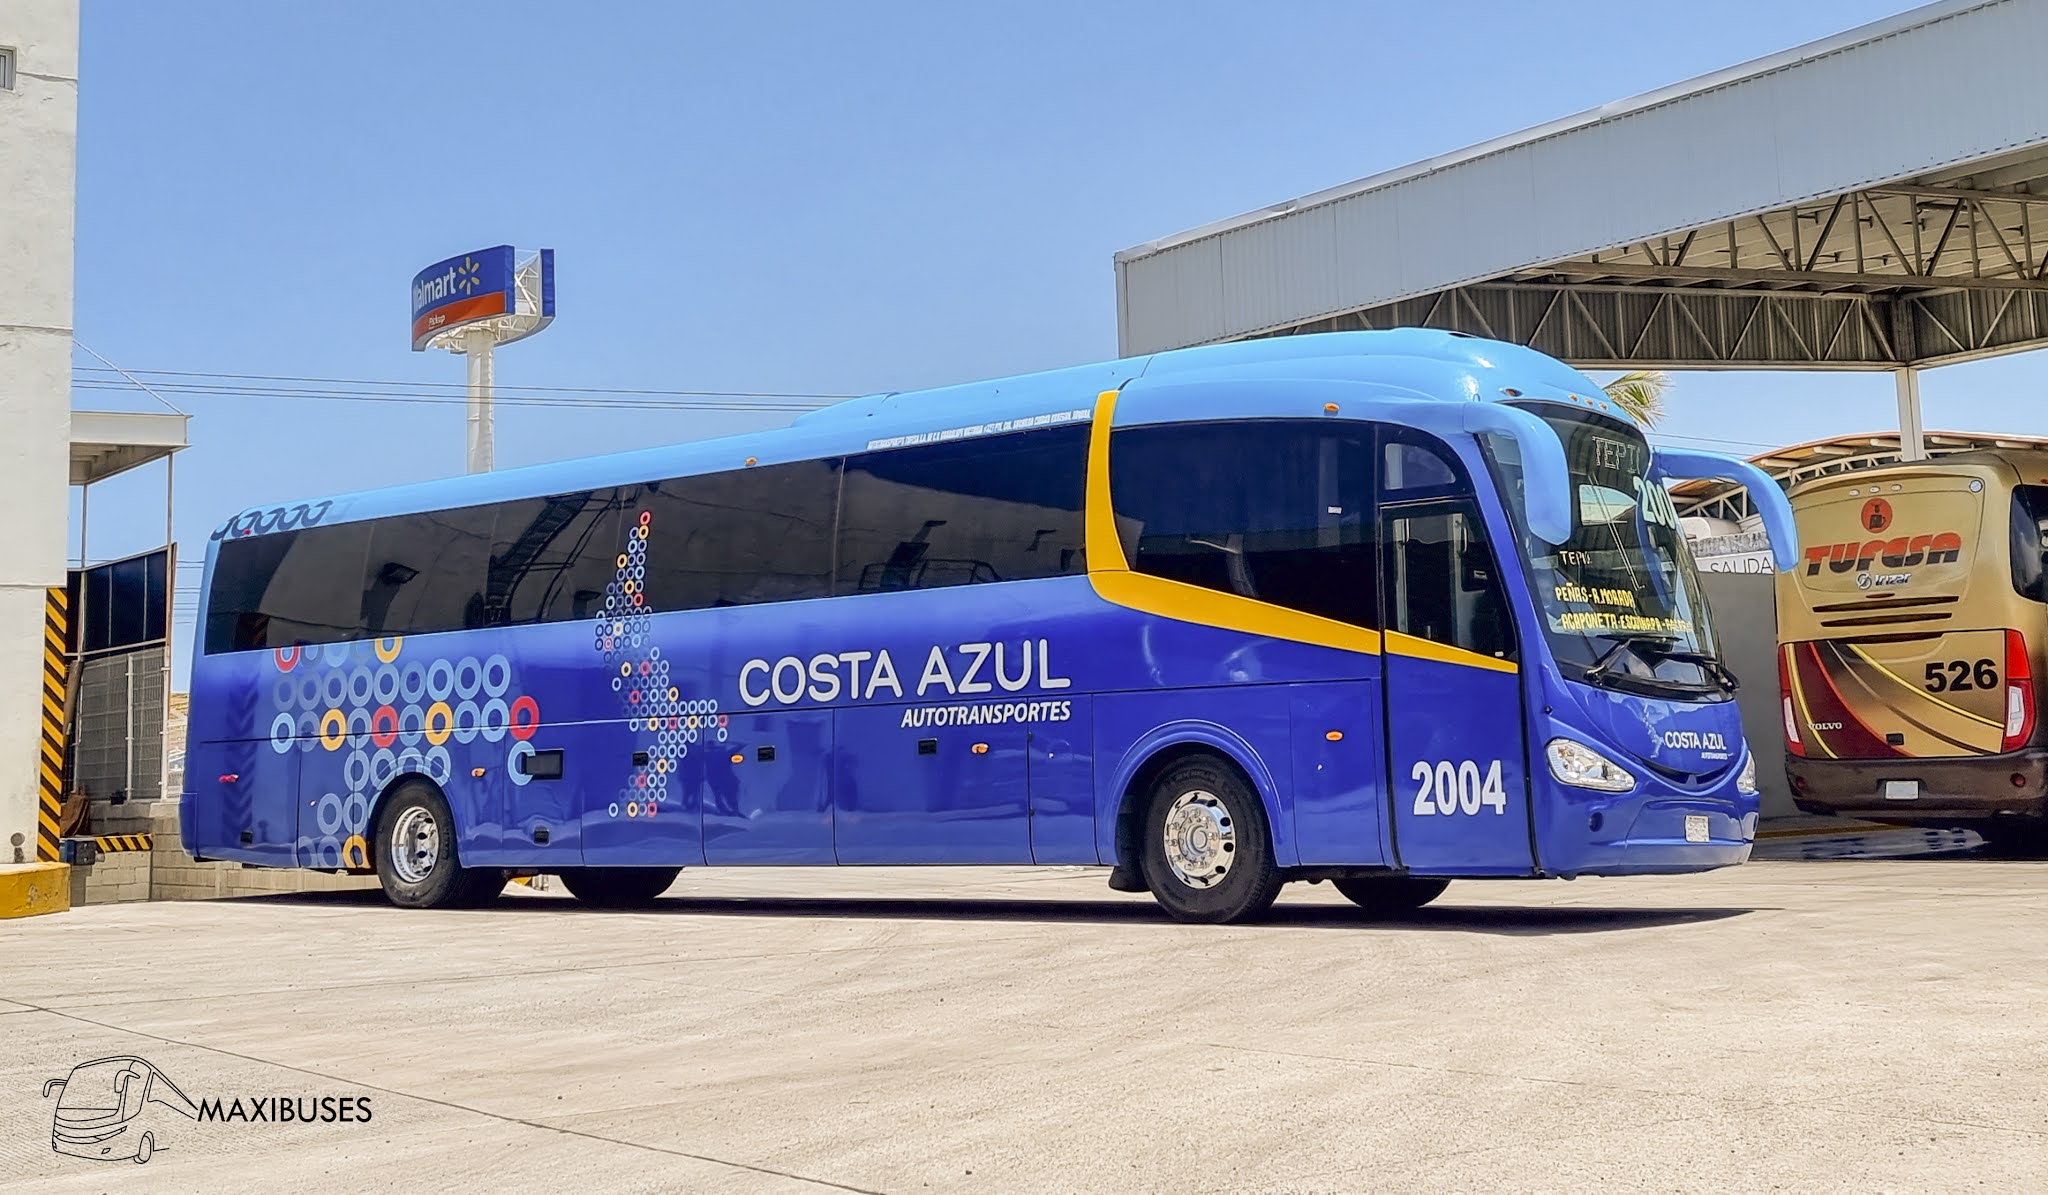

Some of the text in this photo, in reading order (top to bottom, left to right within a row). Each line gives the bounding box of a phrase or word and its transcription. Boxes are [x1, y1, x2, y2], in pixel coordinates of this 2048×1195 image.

[1592, 435, 1641, 475] TEPI
[1710, 556, 1775, 574] SALIDA
[739, 638, 1072, 707] COSTA AZUL
[1925, 658, 1999, 693] 526
[901, 700, 1072, 728] AUTOTRANSPORTES
[1808, 722, 1843, 731] VOLVO
[1664, 731, 1727, 750] COSTA AZUL
[1411, 759, 1507, 816] 2004
